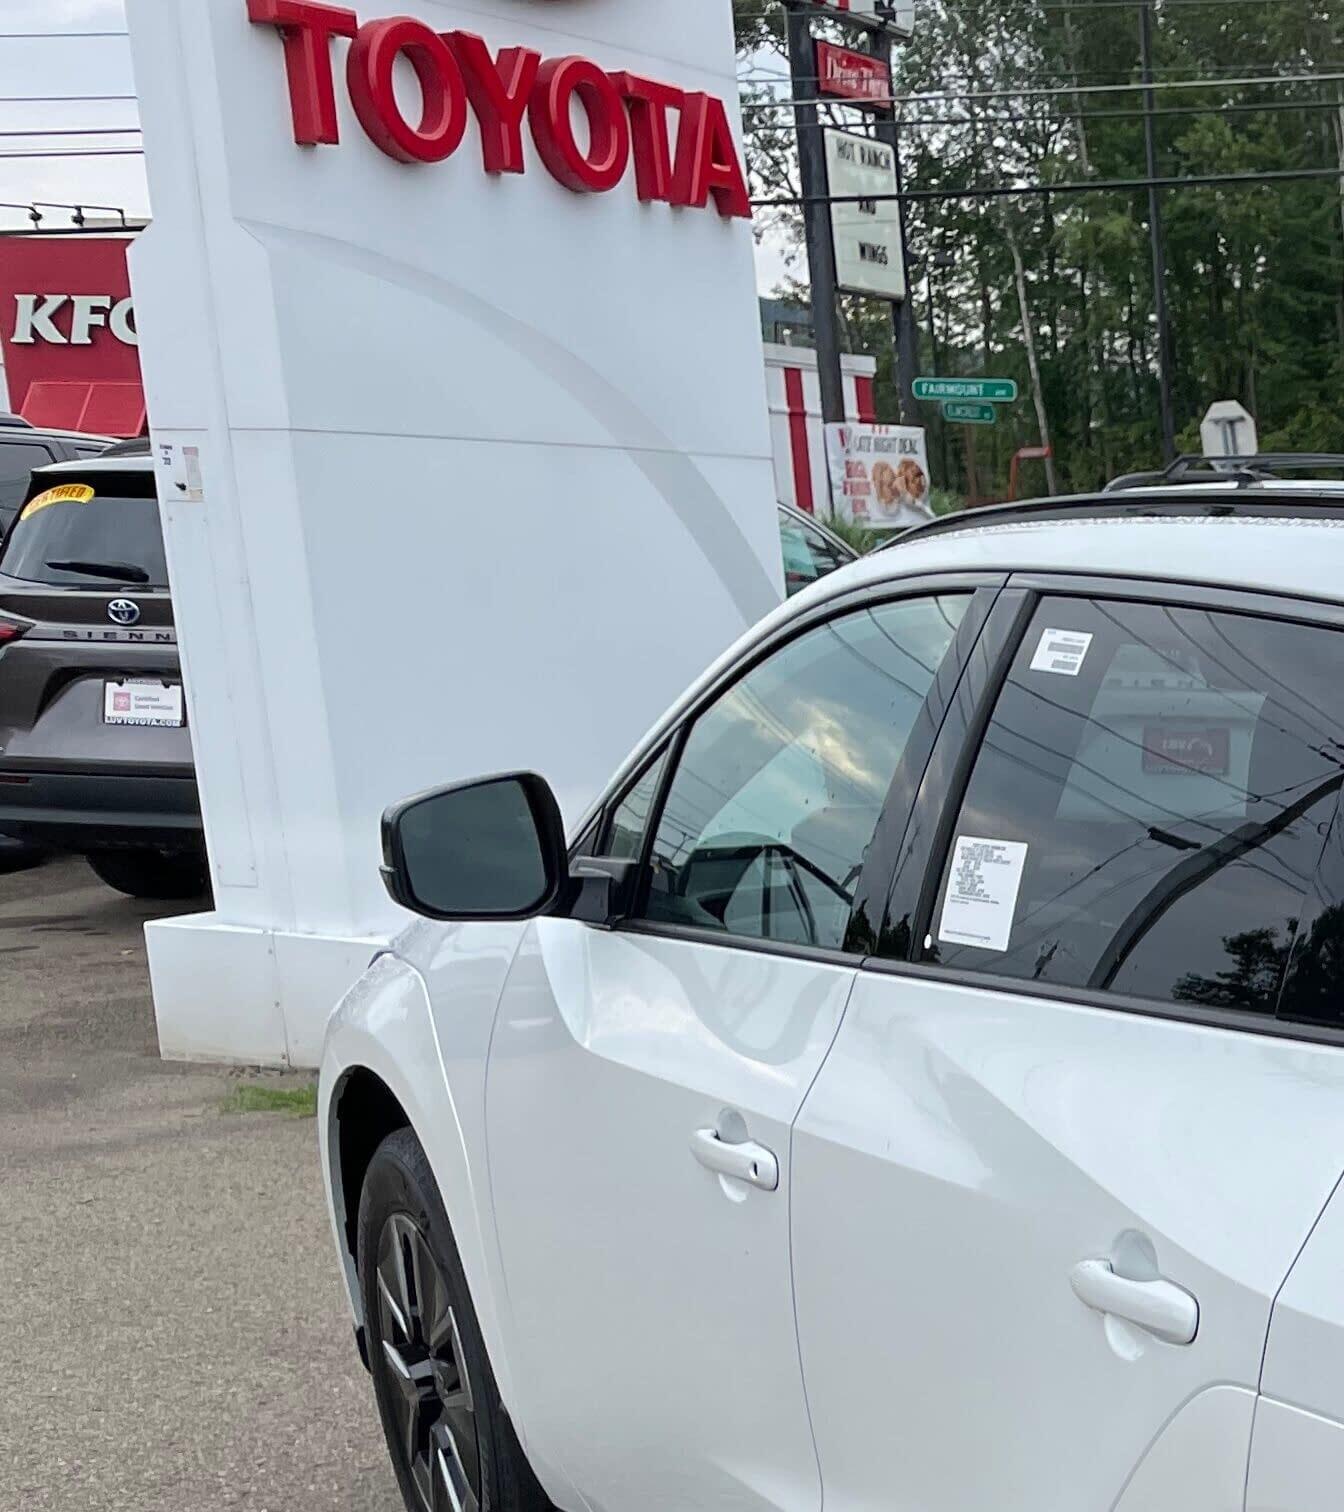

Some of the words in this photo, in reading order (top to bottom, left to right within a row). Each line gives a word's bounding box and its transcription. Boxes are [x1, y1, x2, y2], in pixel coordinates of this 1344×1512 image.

[248, 0, 752, 218] TOYOTA
[858, 240, 889, 266] WINGS
[10, 293, 138, 345] KFC
[921, 382, 984, 397] FAIRMOUNT
[63, 630, 171, 641] SIENN
